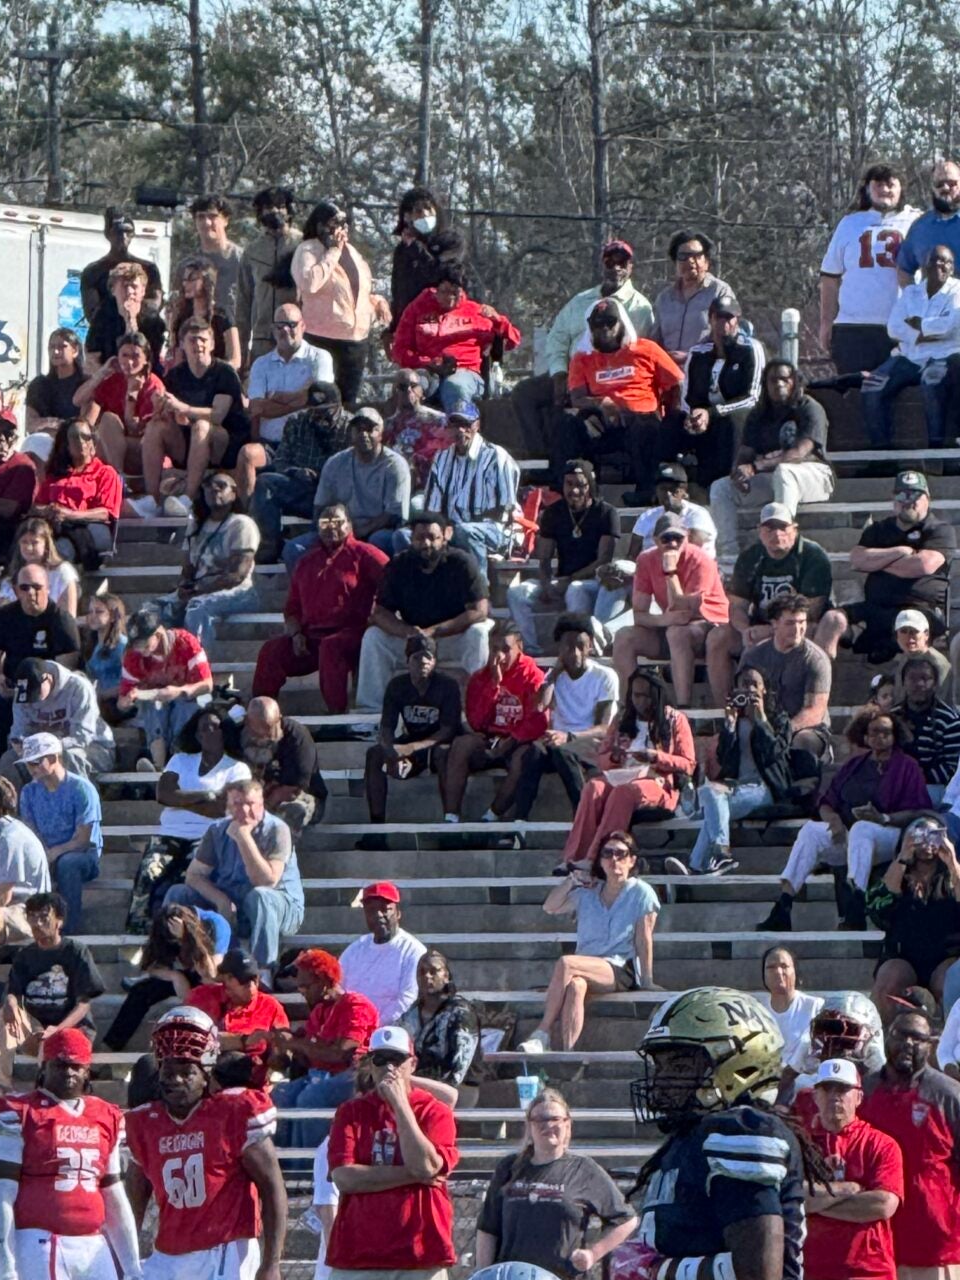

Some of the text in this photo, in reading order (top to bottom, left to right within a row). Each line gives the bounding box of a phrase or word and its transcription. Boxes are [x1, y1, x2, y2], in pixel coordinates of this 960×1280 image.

[858, 229, 904, 268] 13
[158, 1130, 205, 1154] GEORGIA
[54, 1146, 101, 1193] 35
